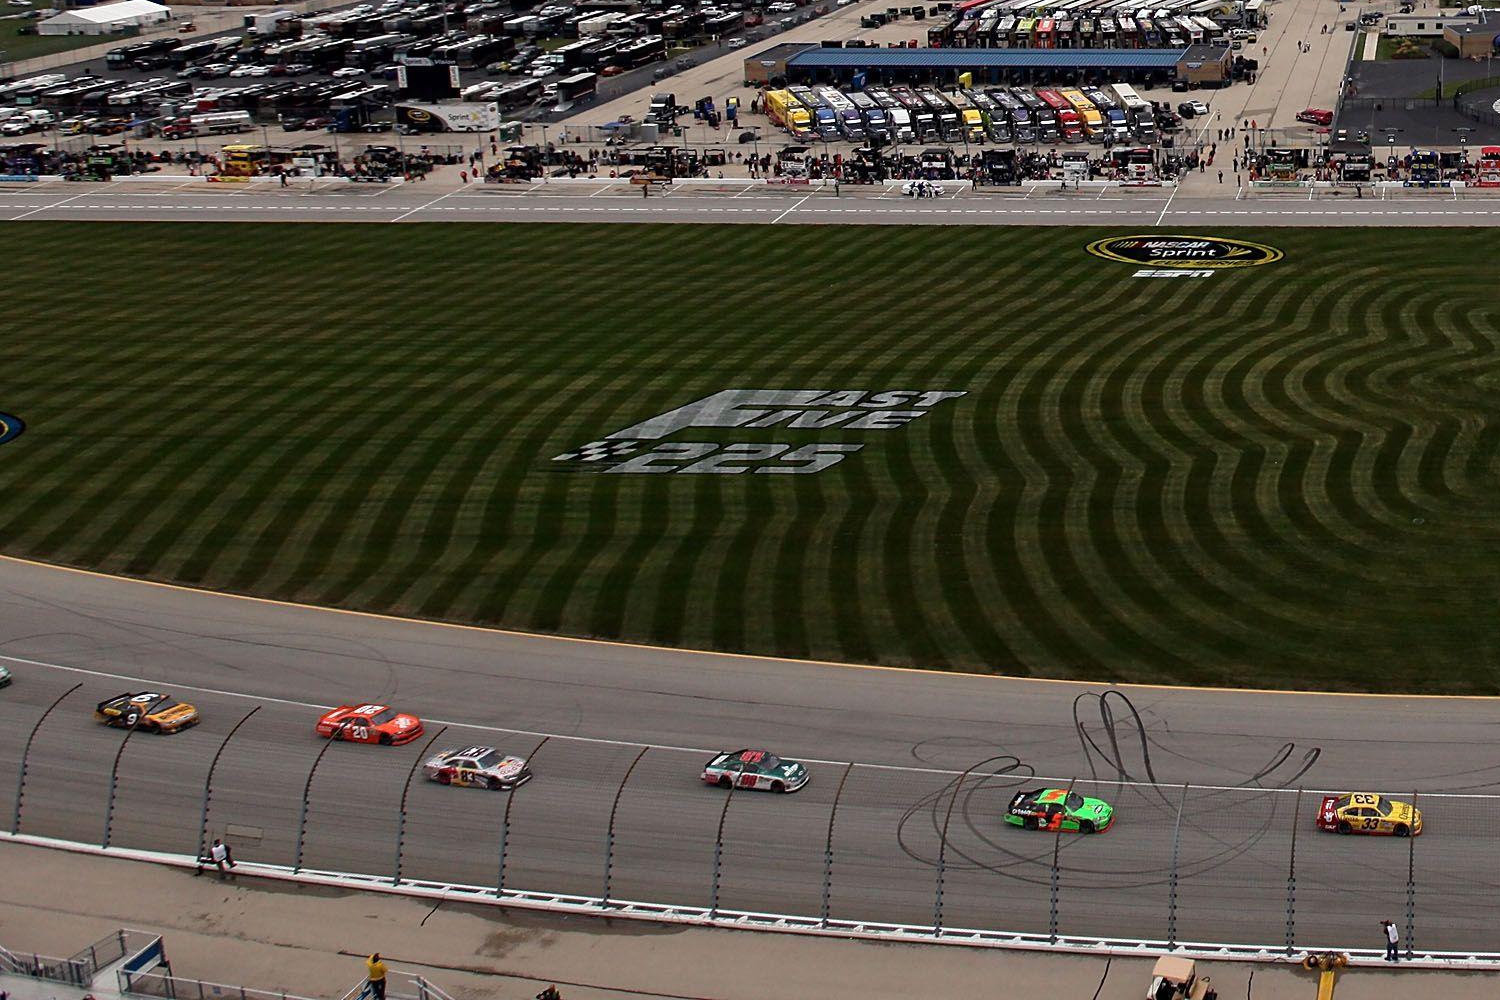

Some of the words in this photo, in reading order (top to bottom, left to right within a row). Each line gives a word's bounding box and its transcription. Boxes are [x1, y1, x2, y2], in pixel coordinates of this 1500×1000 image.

[448, 113, 470, 121] Sprint
[1149, 248, 1217, 258] Sprint
[1132, 269, 1216, 278] ESPN
[602, 443, 866, 474] 225
[127, 713, 138, 725] 9
[352, 725, 368, 740] 20
[461, 770, 475, 783] 83
[1361, 817, 1380, 830] 33
